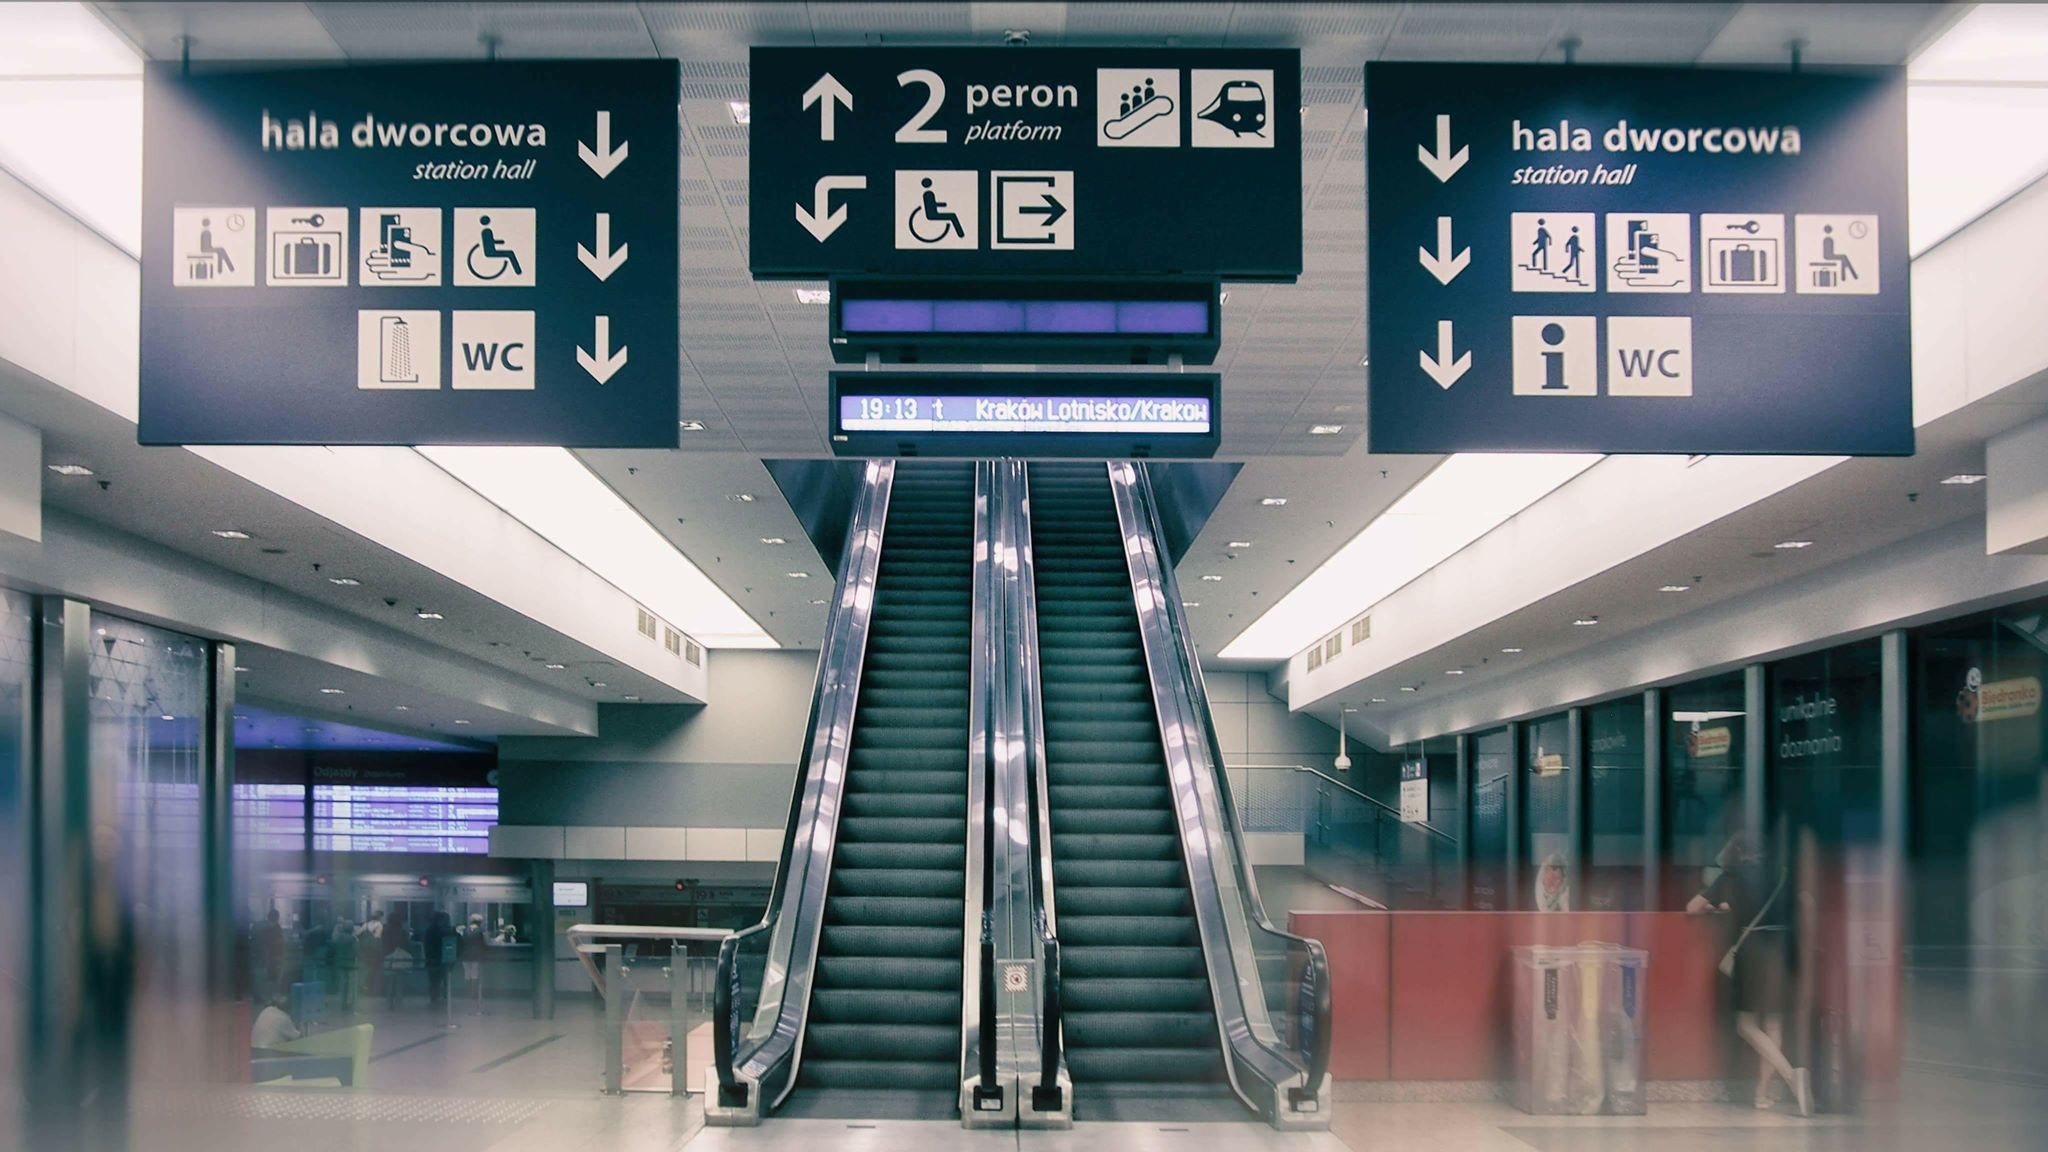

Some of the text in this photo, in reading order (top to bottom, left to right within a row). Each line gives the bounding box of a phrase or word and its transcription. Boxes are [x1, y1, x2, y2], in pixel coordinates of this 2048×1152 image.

[894, 69, 948, 143] 2
[966, 80, 1078, 114] peron
[261, 109, 547, 149] hala dworcowa
[964, 119, 1062, 145] platform
[1512, 119, 1801, 155] hala dworcowa
[413, 159, 537, 180] station hall
[1511, 163, 1638, 185] station hall
[462, 342, 525, 372] WC
[1618, 349, 1680, 378] WC
[860, 397, 918, 420] 19:13
